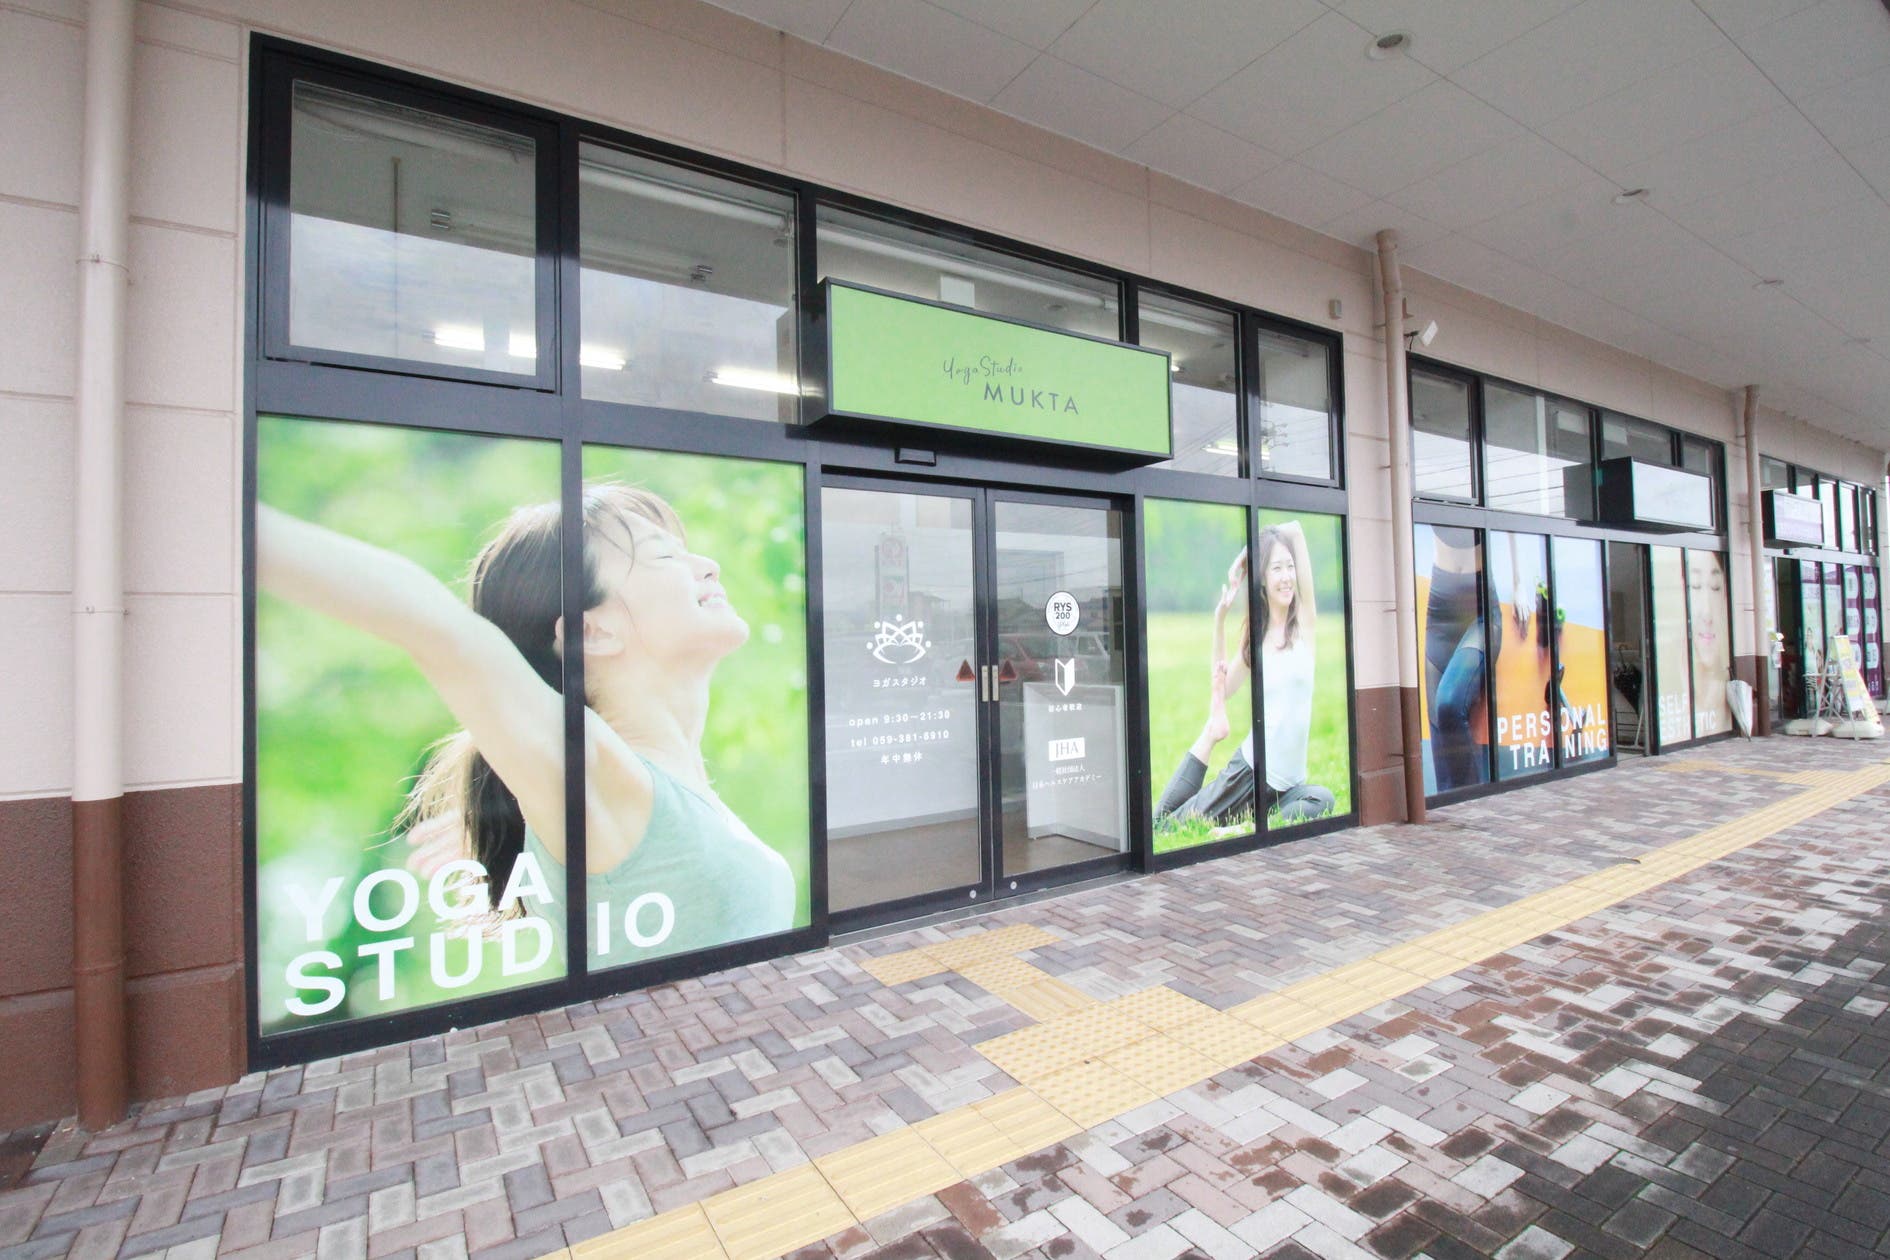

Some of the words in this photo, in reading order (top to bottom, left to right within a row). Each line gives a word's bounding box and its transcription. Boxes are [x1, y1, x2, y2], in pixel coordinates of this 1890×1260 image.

[984, 381, 1079, 415] MUKTA
[1054, 602, 1072, 611] RYS
[873, 676, 926, 688] ヨガスタジオ
[849, 716, 878, 728] open
[1498, 703, 1607, 743] PERSONAL
[851, 737, 867, 748] tel
[284, 851, 554, 942] YOGA
